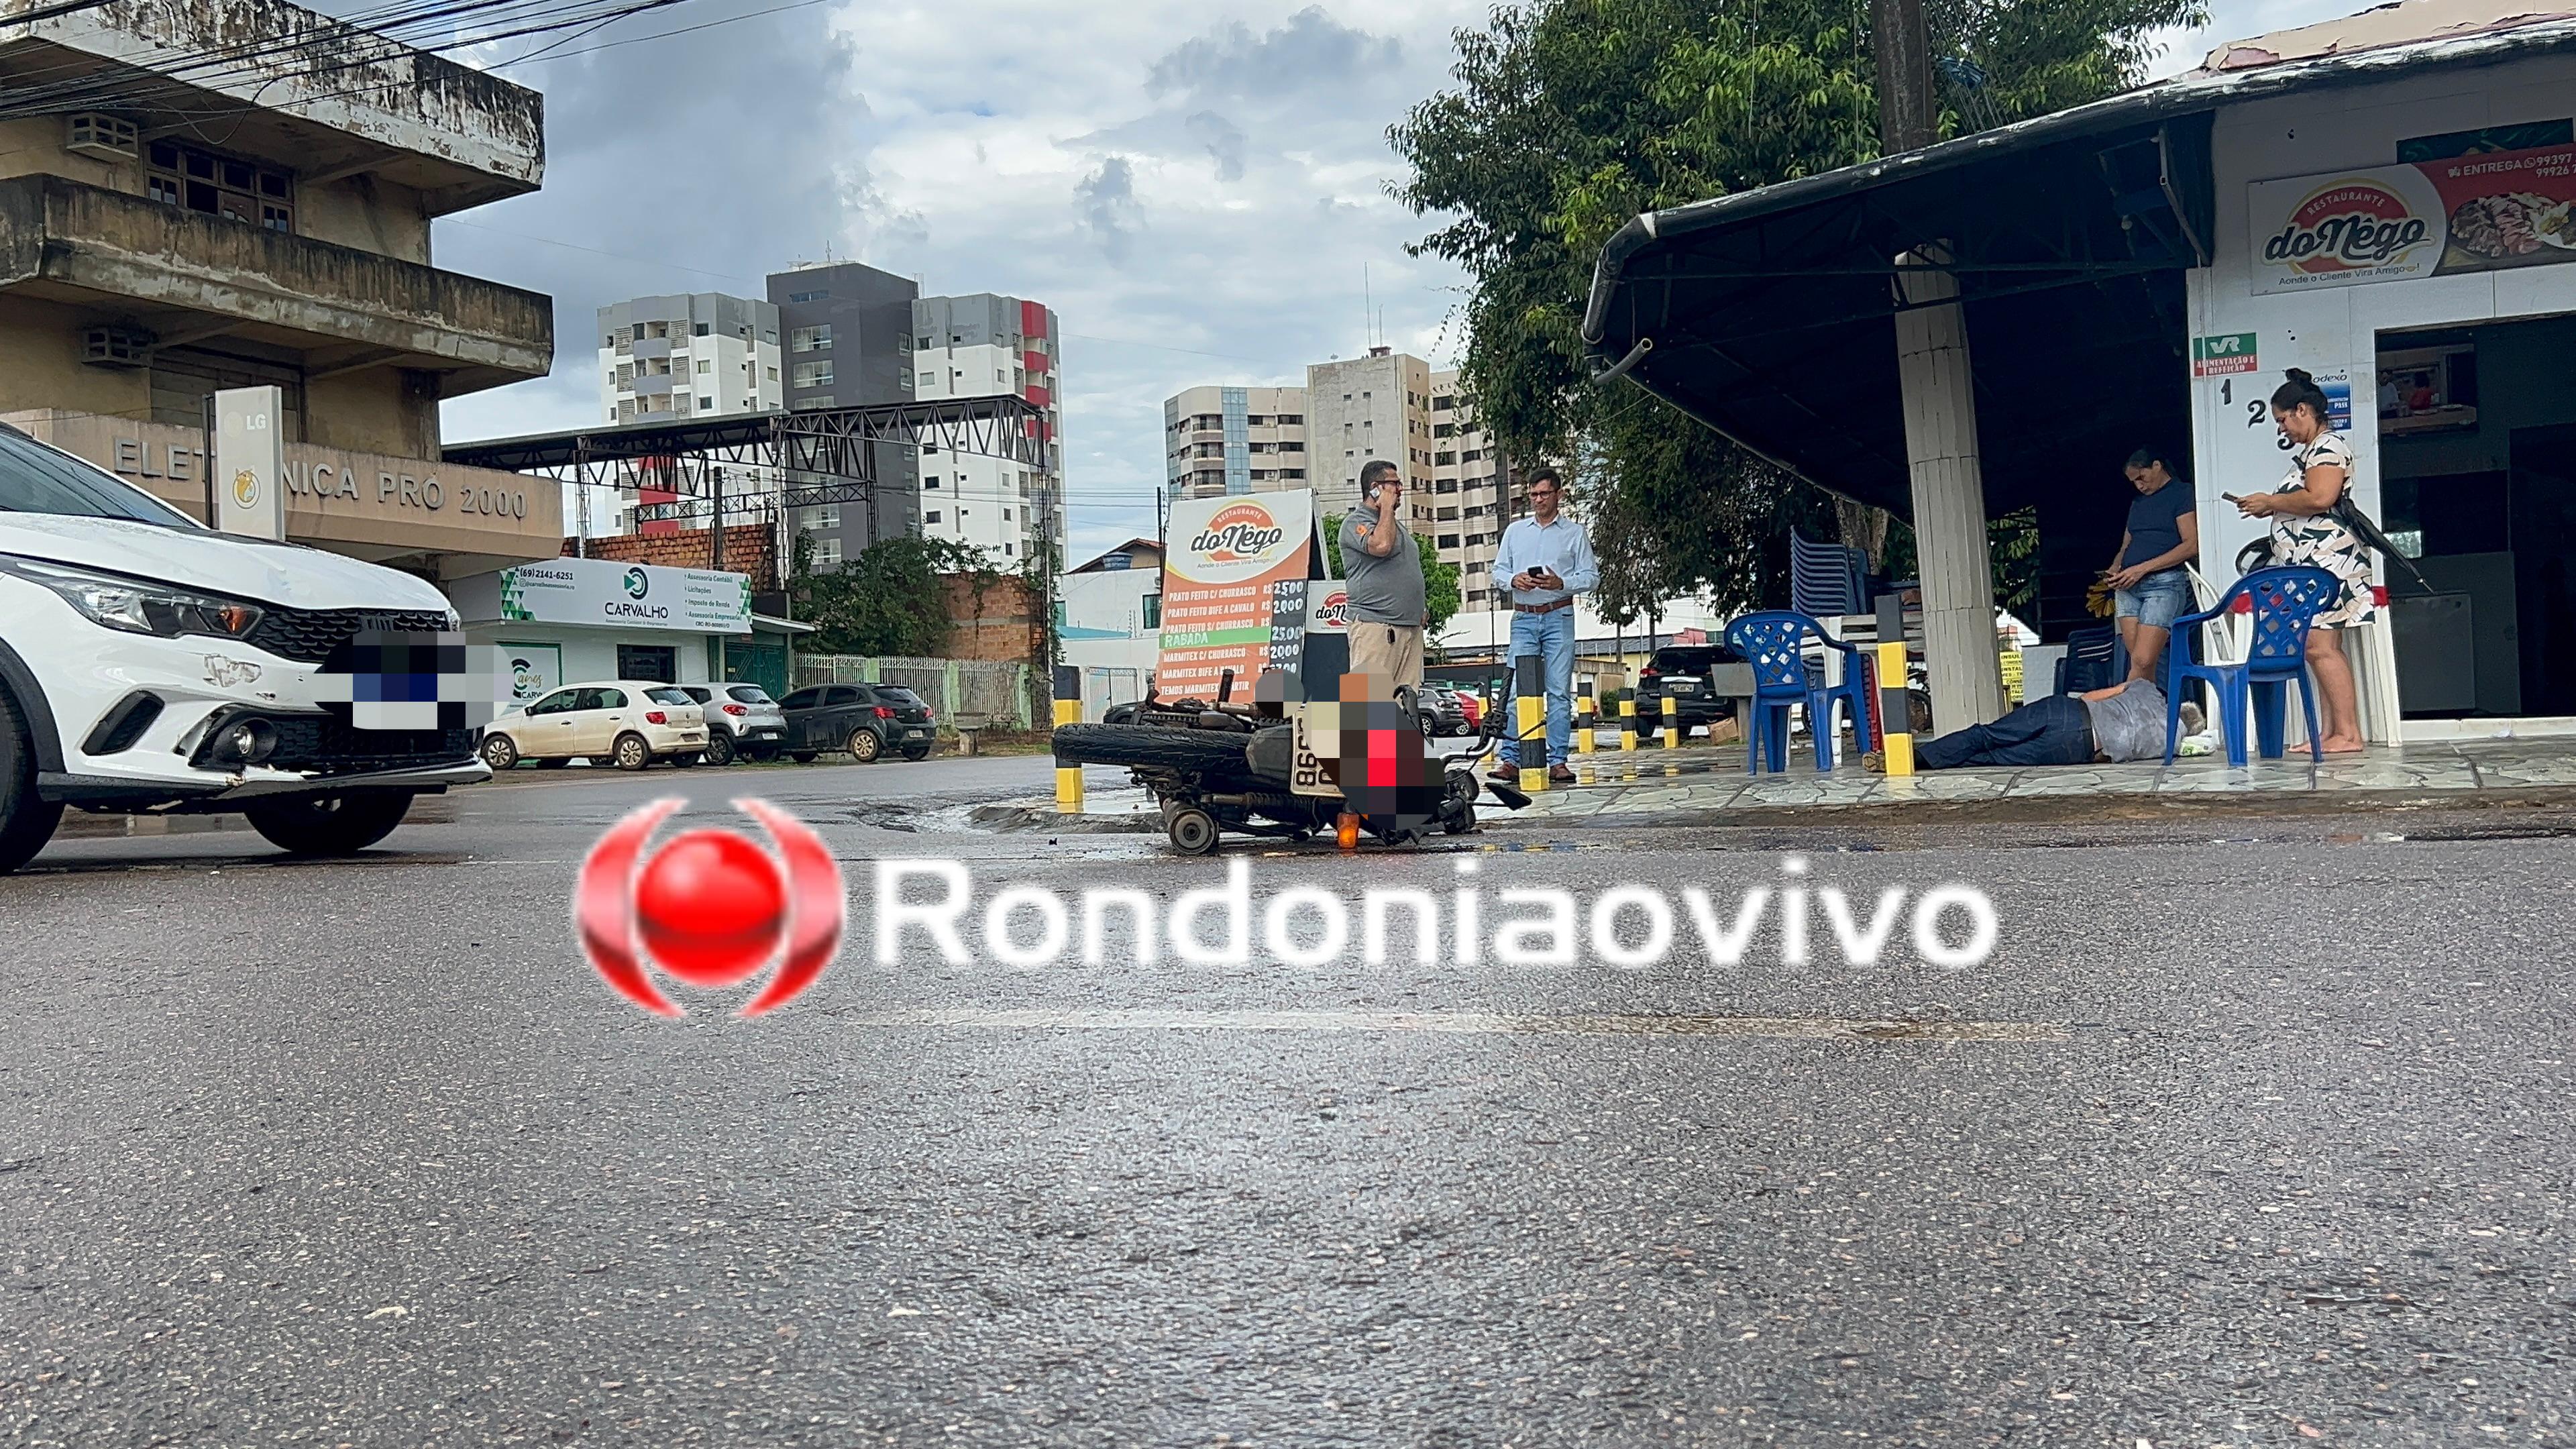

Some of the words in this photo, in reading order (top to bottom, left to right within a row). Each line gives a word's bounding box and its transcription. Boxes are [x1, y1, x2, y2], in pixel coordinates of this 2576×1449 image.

[2463, 159, 2522, 176] ENTREGA
[2536, 153, 2573, 166] 99397
[2536, 165, 2569, 178] 99926
[2307, 191, 2385, 215] RESTAURANTE
[2278, 275, 2308, 286] Aonde
[2320, 271, 2351, 281] Cliente
[2355, 268, 2373, 278] Vira
[2375, 266, 2405, 276] Amigo
[2210, 336, 2240, 354] VR
[2196, 356, 2248, 368] AIMENTAÇÃO
[2249, 356, 2255, 364] E
[2208, 364, 2245, 374] REFEIÇÃO
[2312, 374, 2347, 383] odexo
[2220, 378, 2232, 405] 1
[246, 413, 267, 431] LG
[2247, 399, 2266, 429] 2
[114, 438, 360, 500] ELETNICA
[378, 472, 445, 510] PRO
[460, 486, 528, 519] 2000
[1217, 508, 1263, 523] RESTAURANTE
[1169, 591, 1189, 602] PRATO
[1191, 590, 1208, 600] FEITO
[1210, 590, 1218, 599] C/
[1218, 586, 1256, 598] CHURRASCO
[1263, 583, 1272, 595] R$
[604, 602, 668, 619] CARVALHO
[1167, 607, 1188, 618] PRATO
[1189, 606, 1207, 616] FEITO
[1224, 604, 1230, 614] A
[1230, 602, 1255, 613] CAVALO
[1261, 600, 1271, 611] R$
[1166, 624, 1187, 634] PRATO
[1187, 622, 1206, 633] FEITO
[1207, 622, 1216, 631] S/
[1216, 619, 1254, 631] CHURRASCO
[1261, 616, 1270, 628] R$
[1165, 632, 1208, 647] RABADA
[1163, 651, 1199, 663] MARMITEX
[1199, 650, 1207, 660] C/
[1208, 647, 1246, 660] CHURRASCO
[1259, 646, 1269, 657] R$
[1162, 667, 1197, 679] MARMITEX
[1197, 667, 1213, 677] BIFE
[1213, 666, 1219, 676] A
[1220, 664, 1244, 676] CALO
[1161, 685, 1183, 696] TEMOS
[1184, 683, 1220, 694] MARMITEX
[1231, 681, 1249, 692] ARTIR
